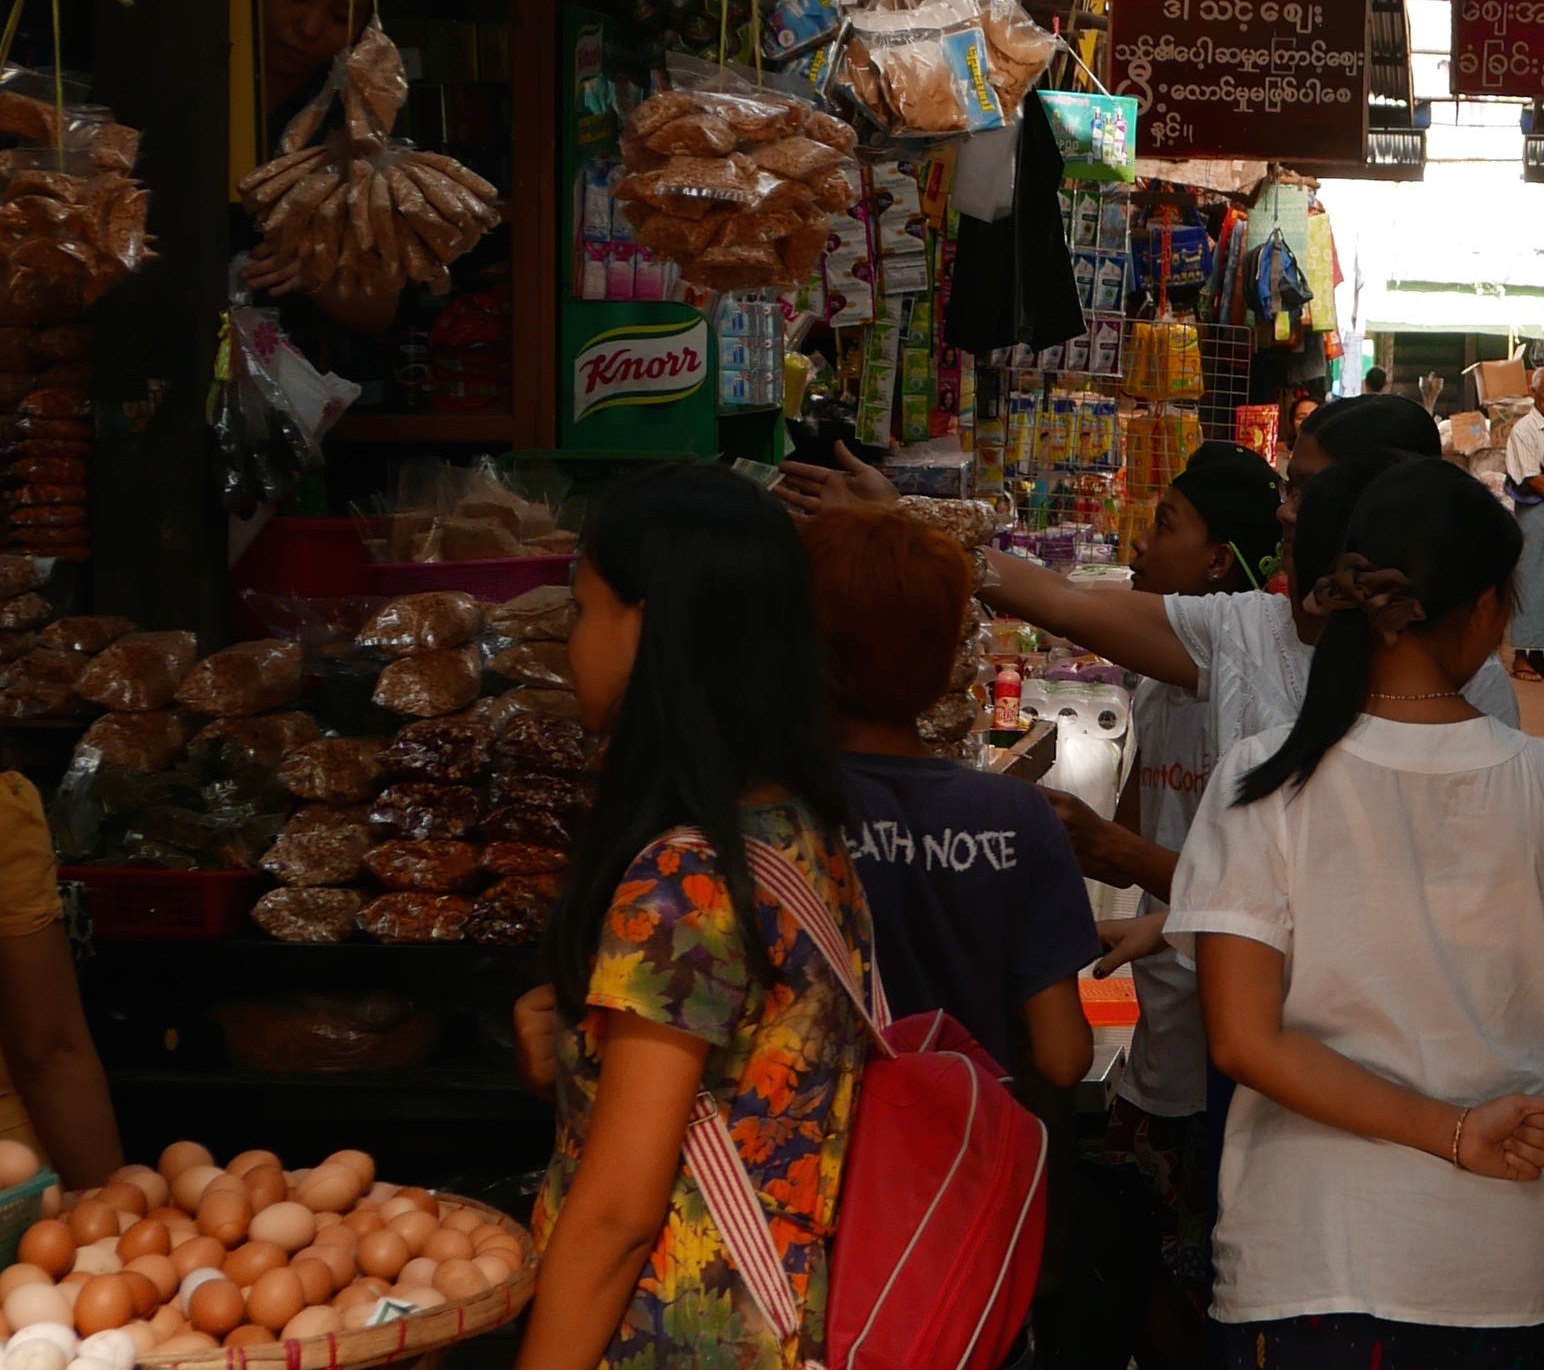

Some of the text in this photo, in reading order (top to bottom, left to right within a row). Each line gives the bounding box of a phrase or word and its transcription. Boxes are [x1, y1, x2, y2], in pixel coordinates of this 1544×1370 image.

[579, 344, 703, 394] Knorr
[840, 820, 1018, 872] EATH NOTE
